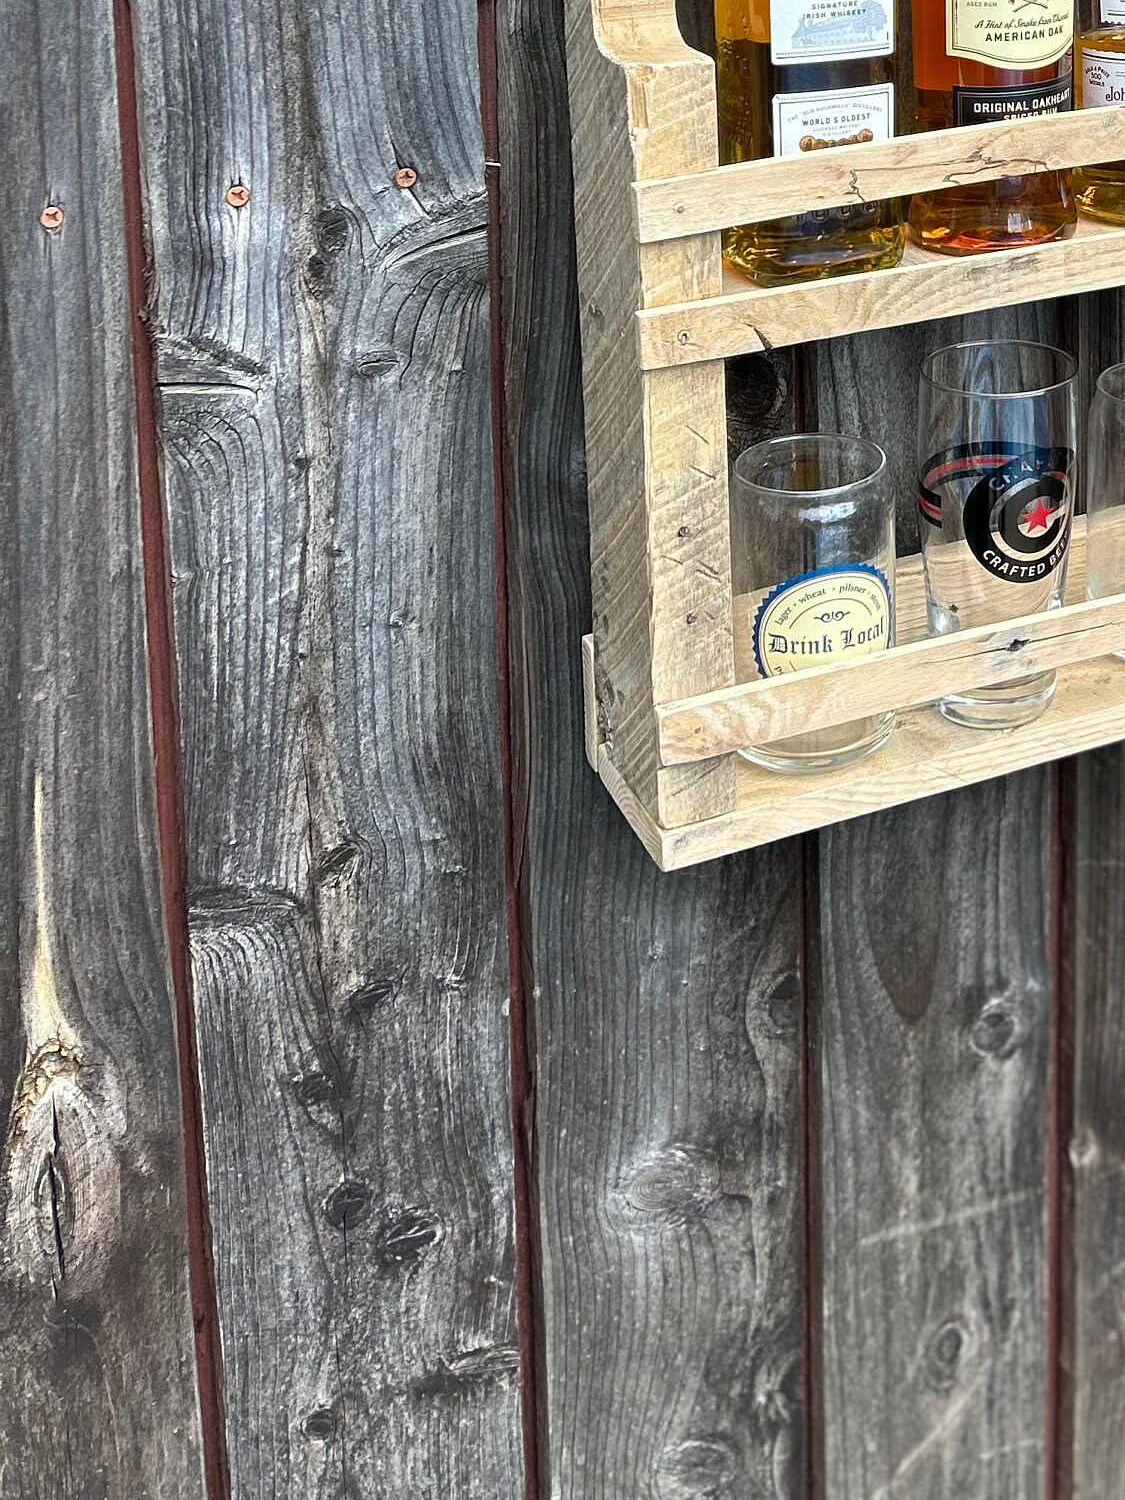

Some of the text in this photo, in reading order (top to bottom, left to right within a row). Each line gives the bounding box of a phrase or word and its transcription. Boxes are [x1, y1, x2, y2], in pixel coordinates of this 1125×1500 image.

[803, 8, 867, 20] IRISH WHISKEY
[811, 0, 858, 10] SIGNATURE
[985, 25, 1064, 42] AMERICAN OAK
[973, 87, 1071, 113] ORIGINAL OAKHEART
[802, 112, 871, 126] WORLD'S OLDEST
[982, 550, 1046, 577] CRAFTED
[798, 588, 826, 604] wheat
[838, 583, 867, 594] pilsner
[768, 616, 884, 655] Drink Local
